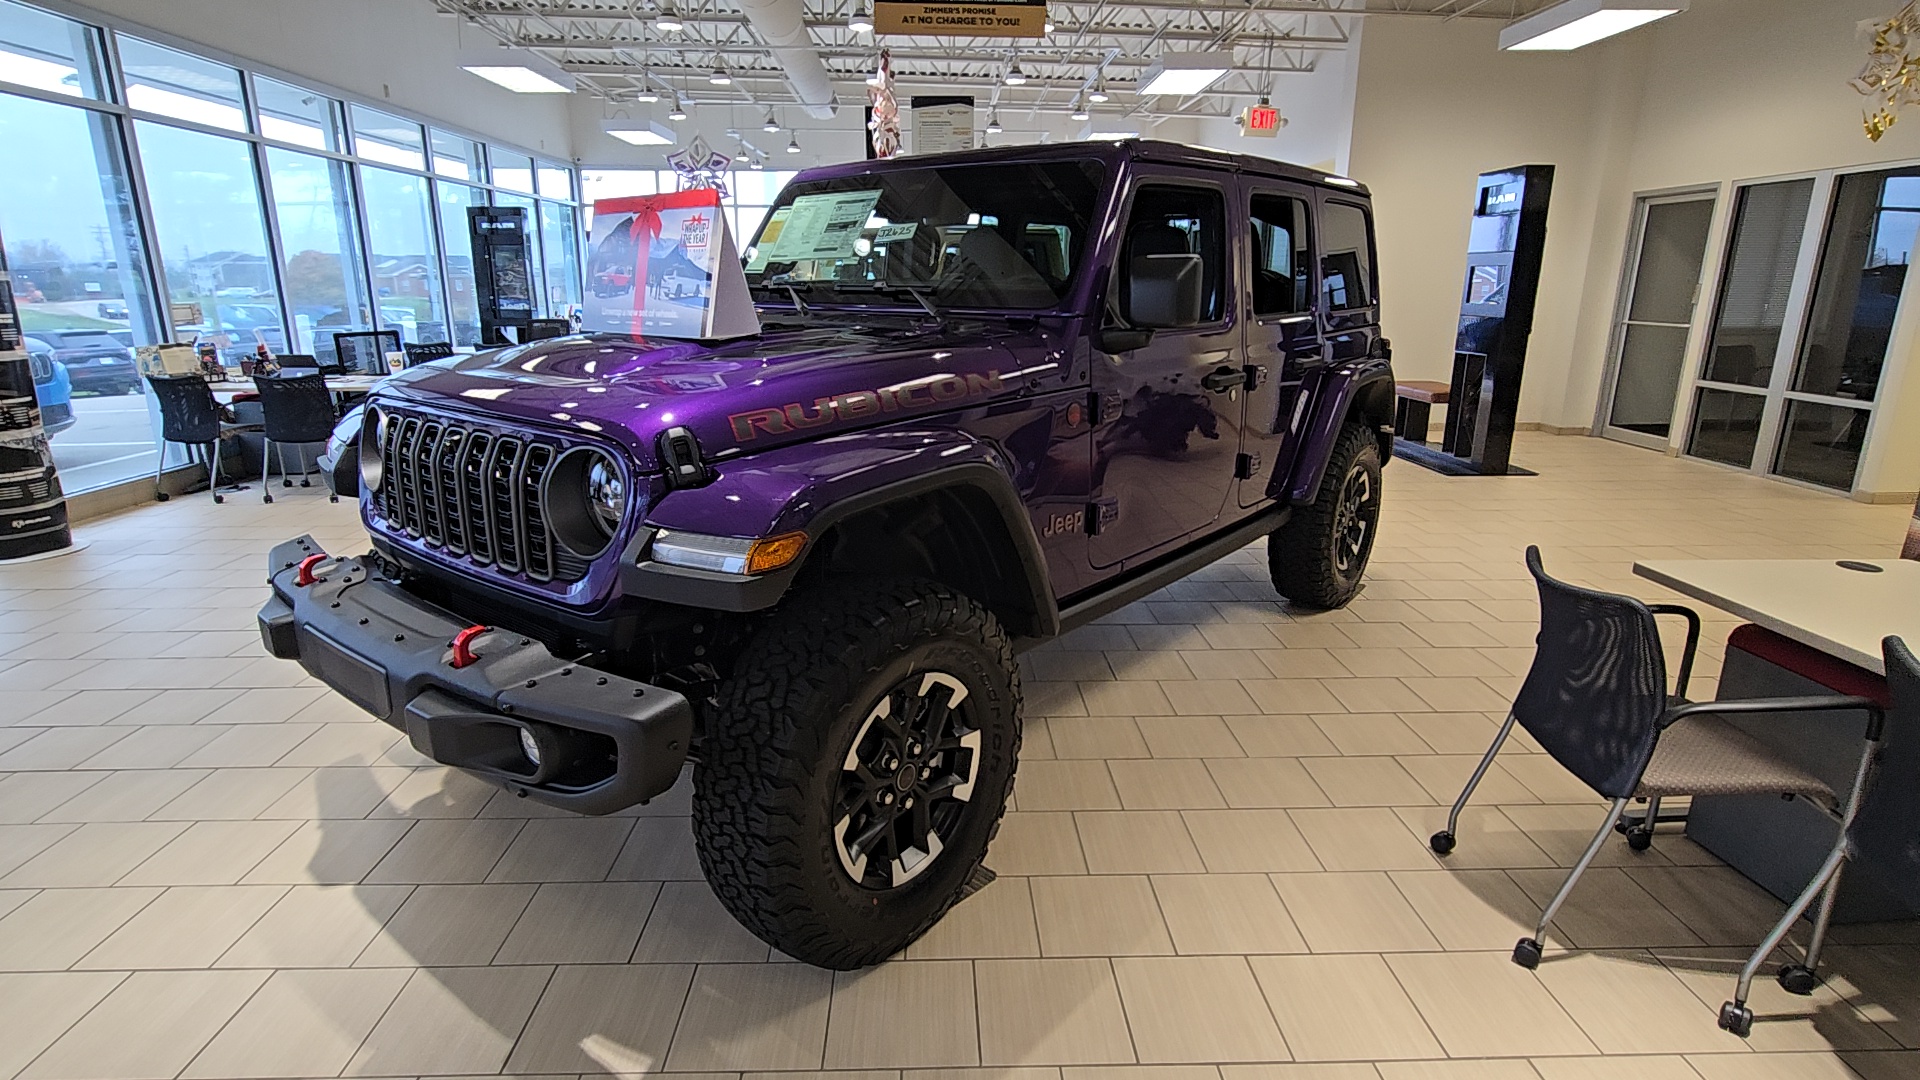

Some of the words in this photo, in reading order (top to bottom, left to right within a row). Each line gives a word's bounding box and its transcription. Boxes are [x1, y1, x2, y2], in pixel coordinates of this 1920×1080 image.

[923, 7, 960, 15] ZIMMER'S
[962, 8, 996, 16] PROMISE
[902, 16, 915, 24] AT
[918, 16, 933, 24] NO
[936, 17, 976, 25] CHARGE
[995, 18, 1020, 26] YOU!
[1251, 110, 1276, 129] EXIT
[685, 223, 698, 233] WRAP
[699, 223, 706, 233] UP
[684, 234, 692, 244] THE
[693, 233, 706, 244] YEAR
[728, 369, 1004, 442] RUBICON
[1043, 510, 1083, 538] Jeep
